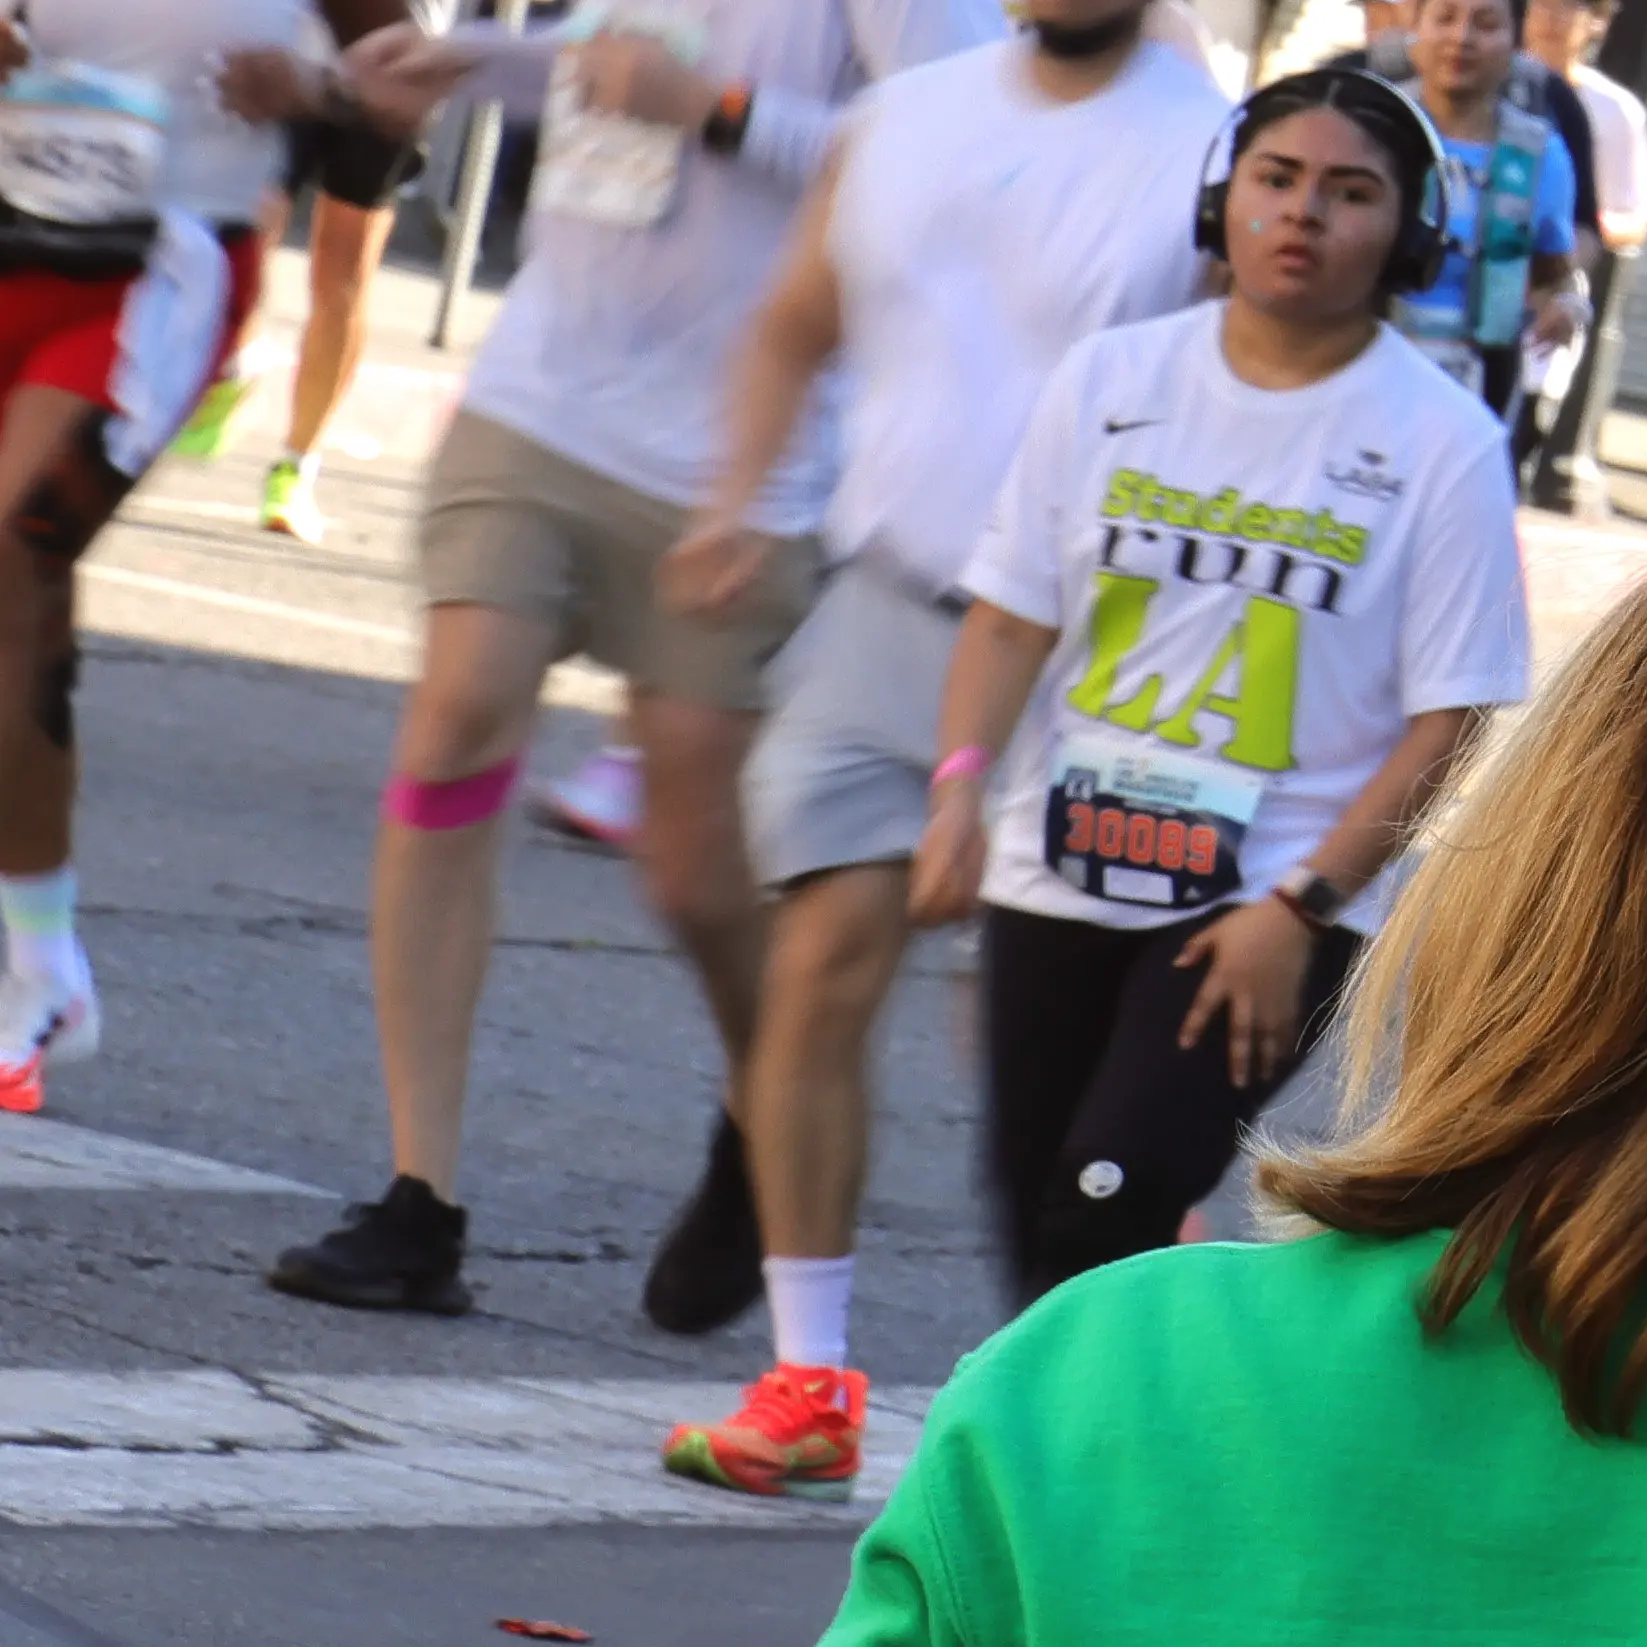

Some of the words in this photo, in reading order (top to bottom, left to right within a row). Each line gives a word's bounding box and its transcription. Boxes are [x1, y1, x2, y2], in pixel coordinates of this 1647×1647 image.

[1099, 466, 1368, 568] Students
[1100, 523, 1343, 617] run
[1065, 569, 1303, 772] LA
[1064, 801, 1219, 876] 30089
